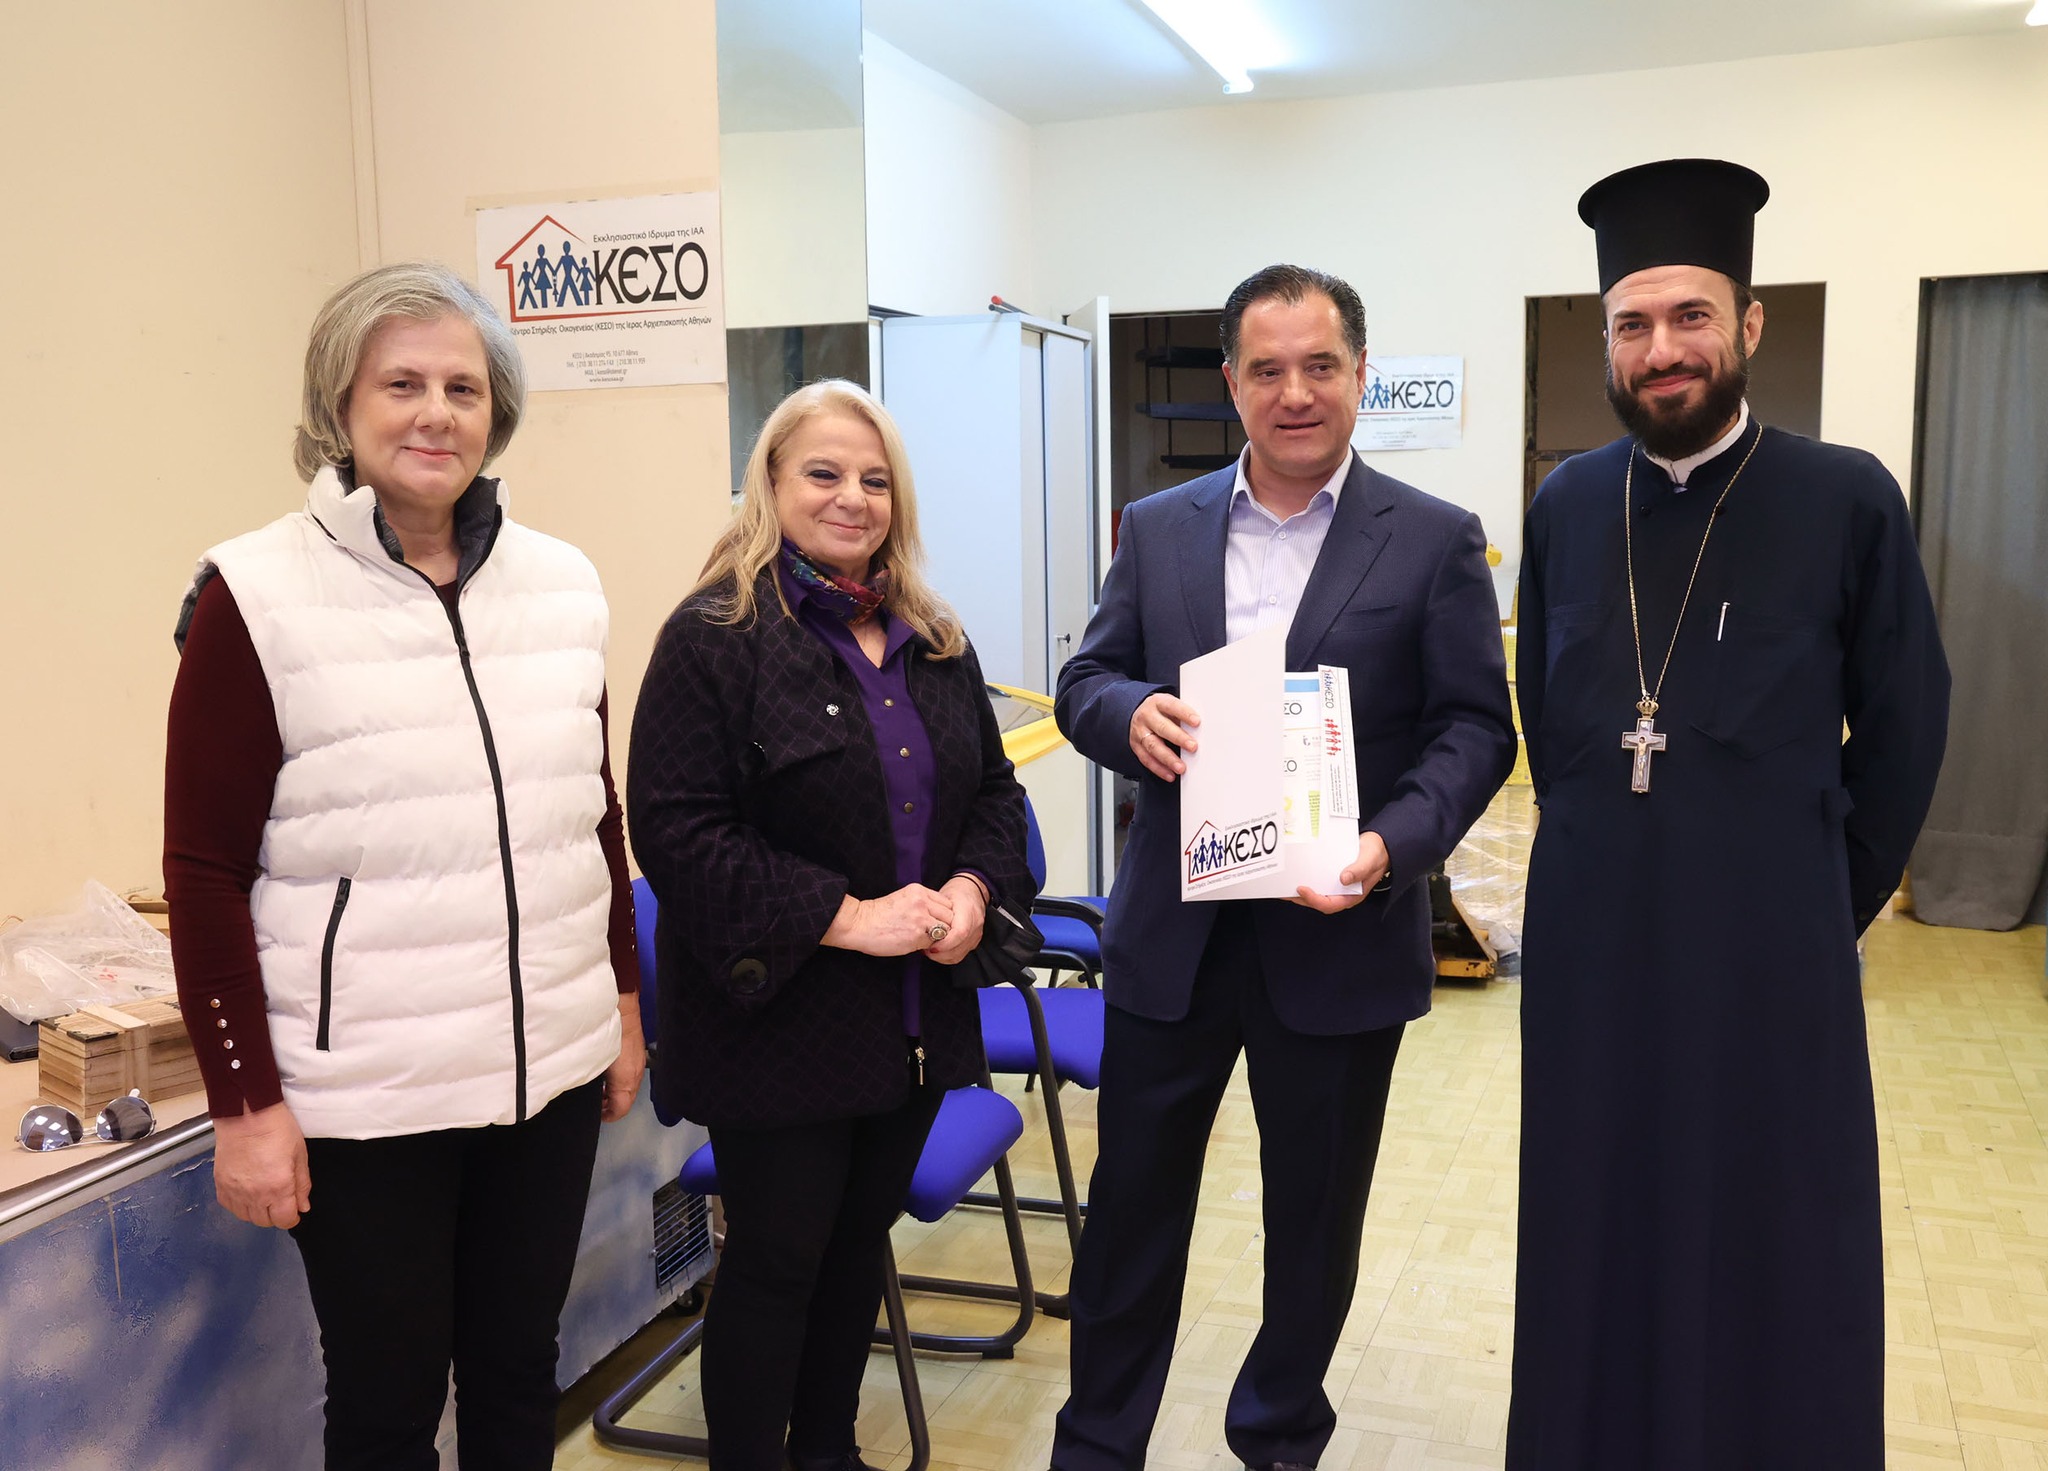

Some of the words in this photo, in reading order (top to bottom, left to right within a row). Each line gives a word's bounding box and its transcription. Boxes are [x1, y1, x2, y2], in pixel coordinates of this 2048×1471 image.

[593, 231, 647, 243] Εκκλησιαστικό
[677, 229, 690, 238] της
[691, 227, 704, 235] ΙΑΑ
[593, 242, 708, 305] ΚΕΣΟ
[595, 322, 614, 331] (ΚΕΣΟ)
[1392, 380, 1454, 409] ΚΕΣΟ
[1224, 821, 1278, 866] ΚΕΣΟ
